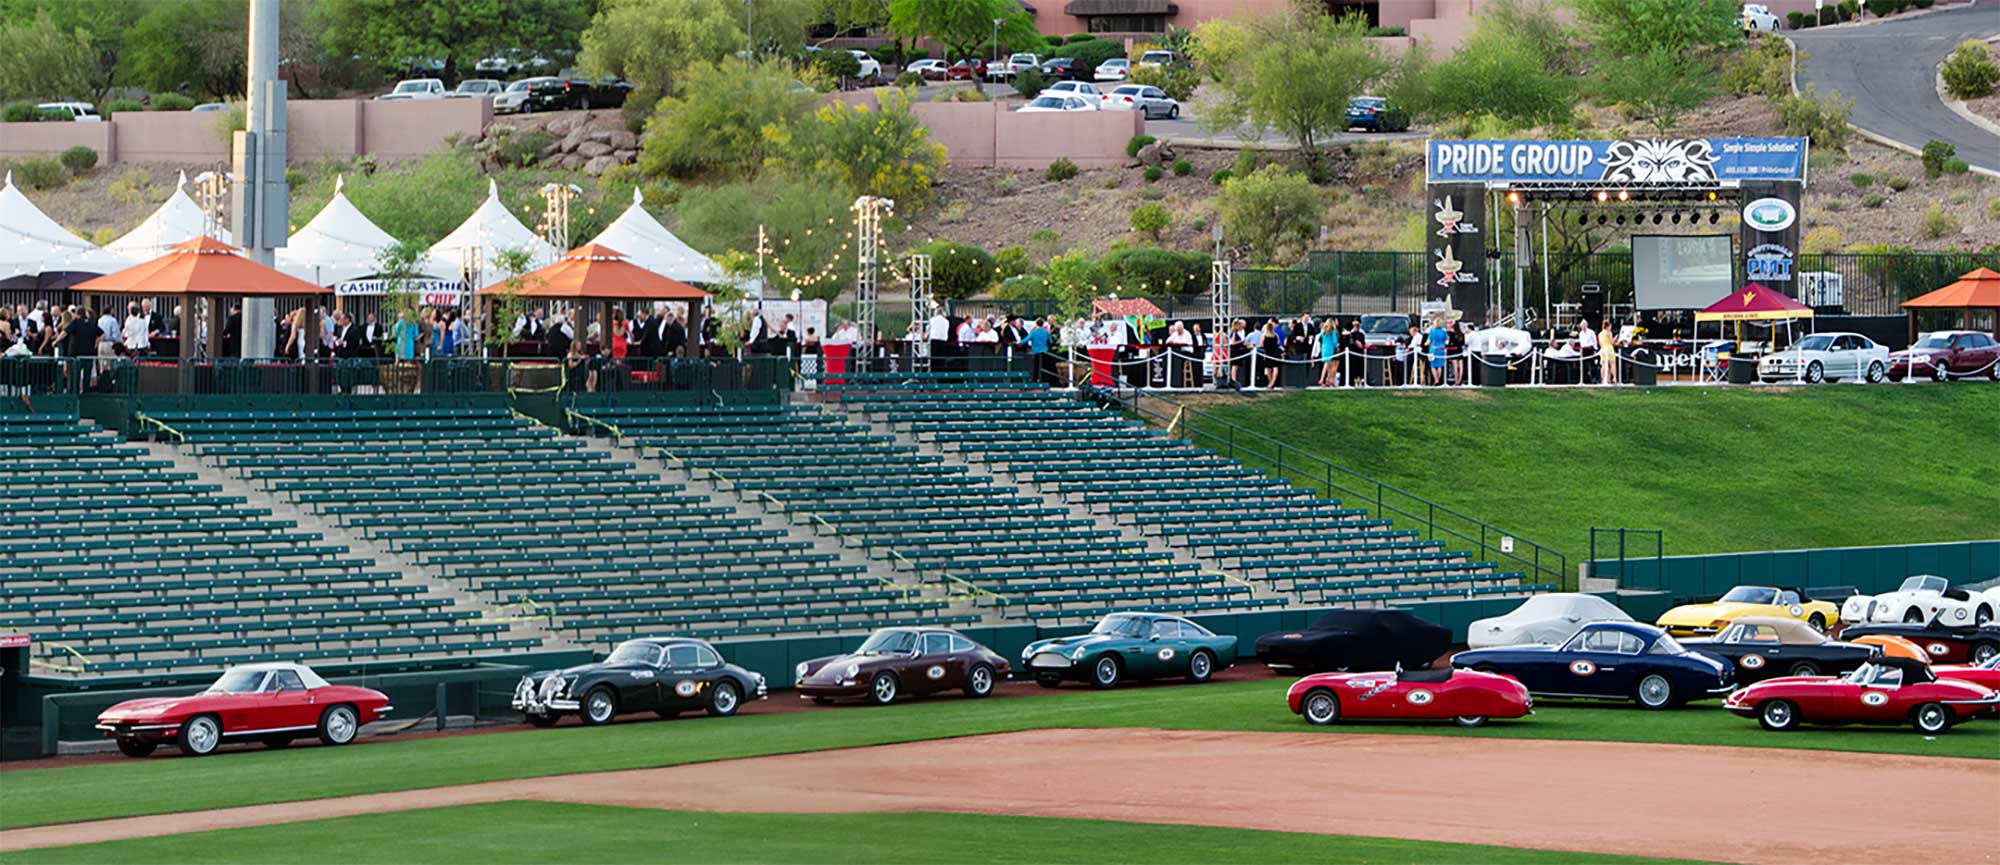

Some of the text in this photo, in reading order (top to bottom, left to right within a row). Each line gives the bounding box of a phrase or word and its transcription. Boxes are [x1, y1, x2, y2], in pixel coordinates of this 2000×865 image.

[1722, 143, 1743, 154] Single
[1744, 143, 1767, 154] Simple
[1436, 144, 1594, 176] PRIDE GROUP
[1747, 258, 1793, 274] PMT
[425, 293, 457, 305] CHIP
[1413, 693, 1427, 702] 36
[1870, 695, 1880, 703] 19
